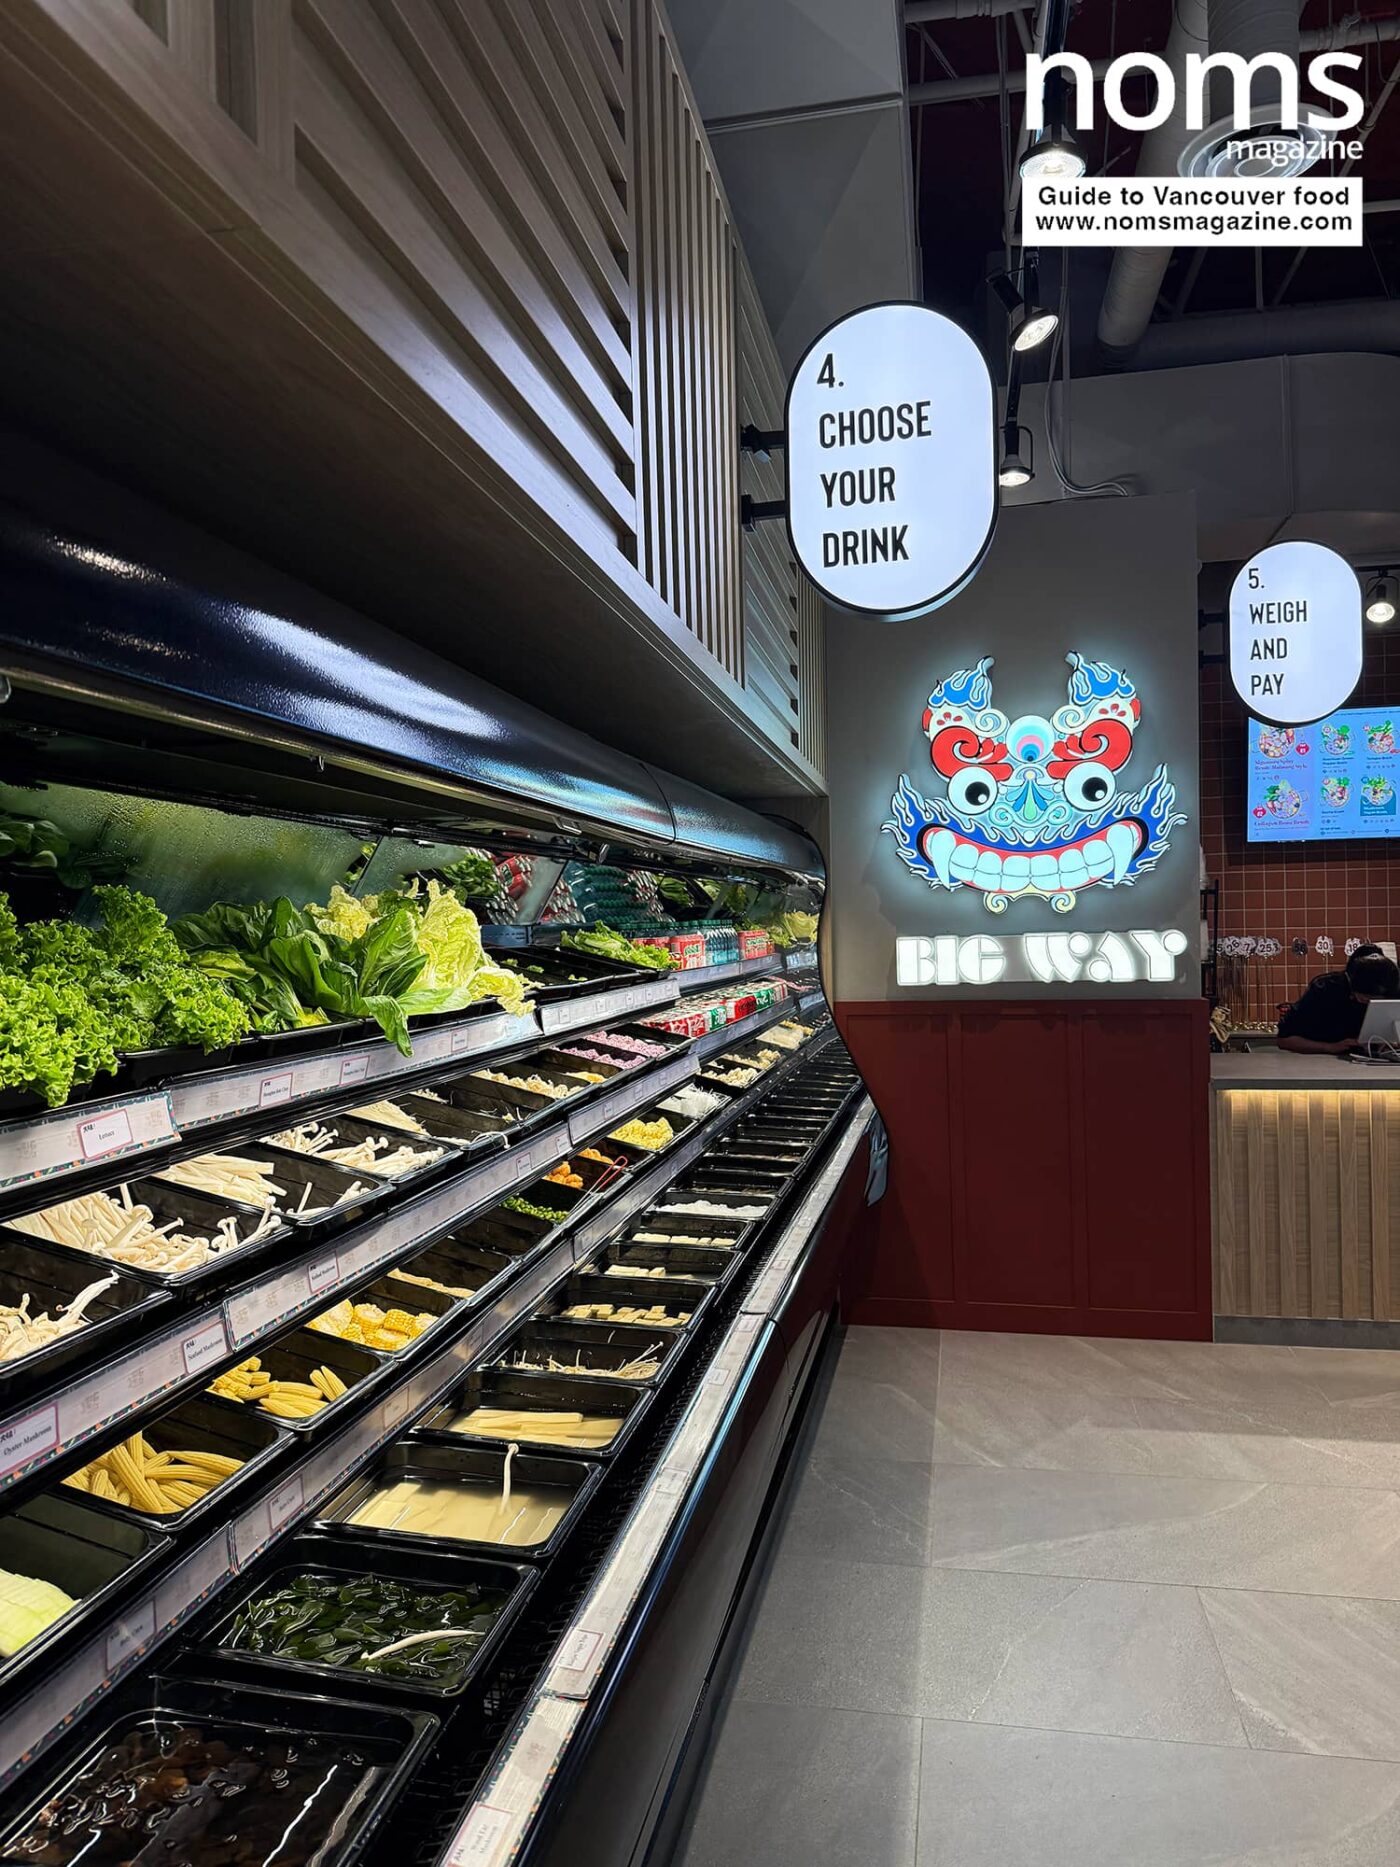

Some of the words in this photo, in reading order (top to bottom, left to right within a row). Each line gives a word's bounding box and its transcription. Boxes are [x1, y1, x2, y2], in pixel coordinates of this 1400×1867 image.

[816, 353, 845, 388] 4.
[818, 400, 932, 449] CHOOSE
[819, 466, 896, 508] YOUR
[822, 524, 910, 568] DRINK
[1248, 568, 1265, 590] 5.
[1249, 600, 1308, 626] WEIGH
[1250, 637, 1288, 661] AND
[1250, 673, 1285, 696] PAY
[896, 933, 1007, 987] BIG
[1023, 929, 1189, 983] WAY
